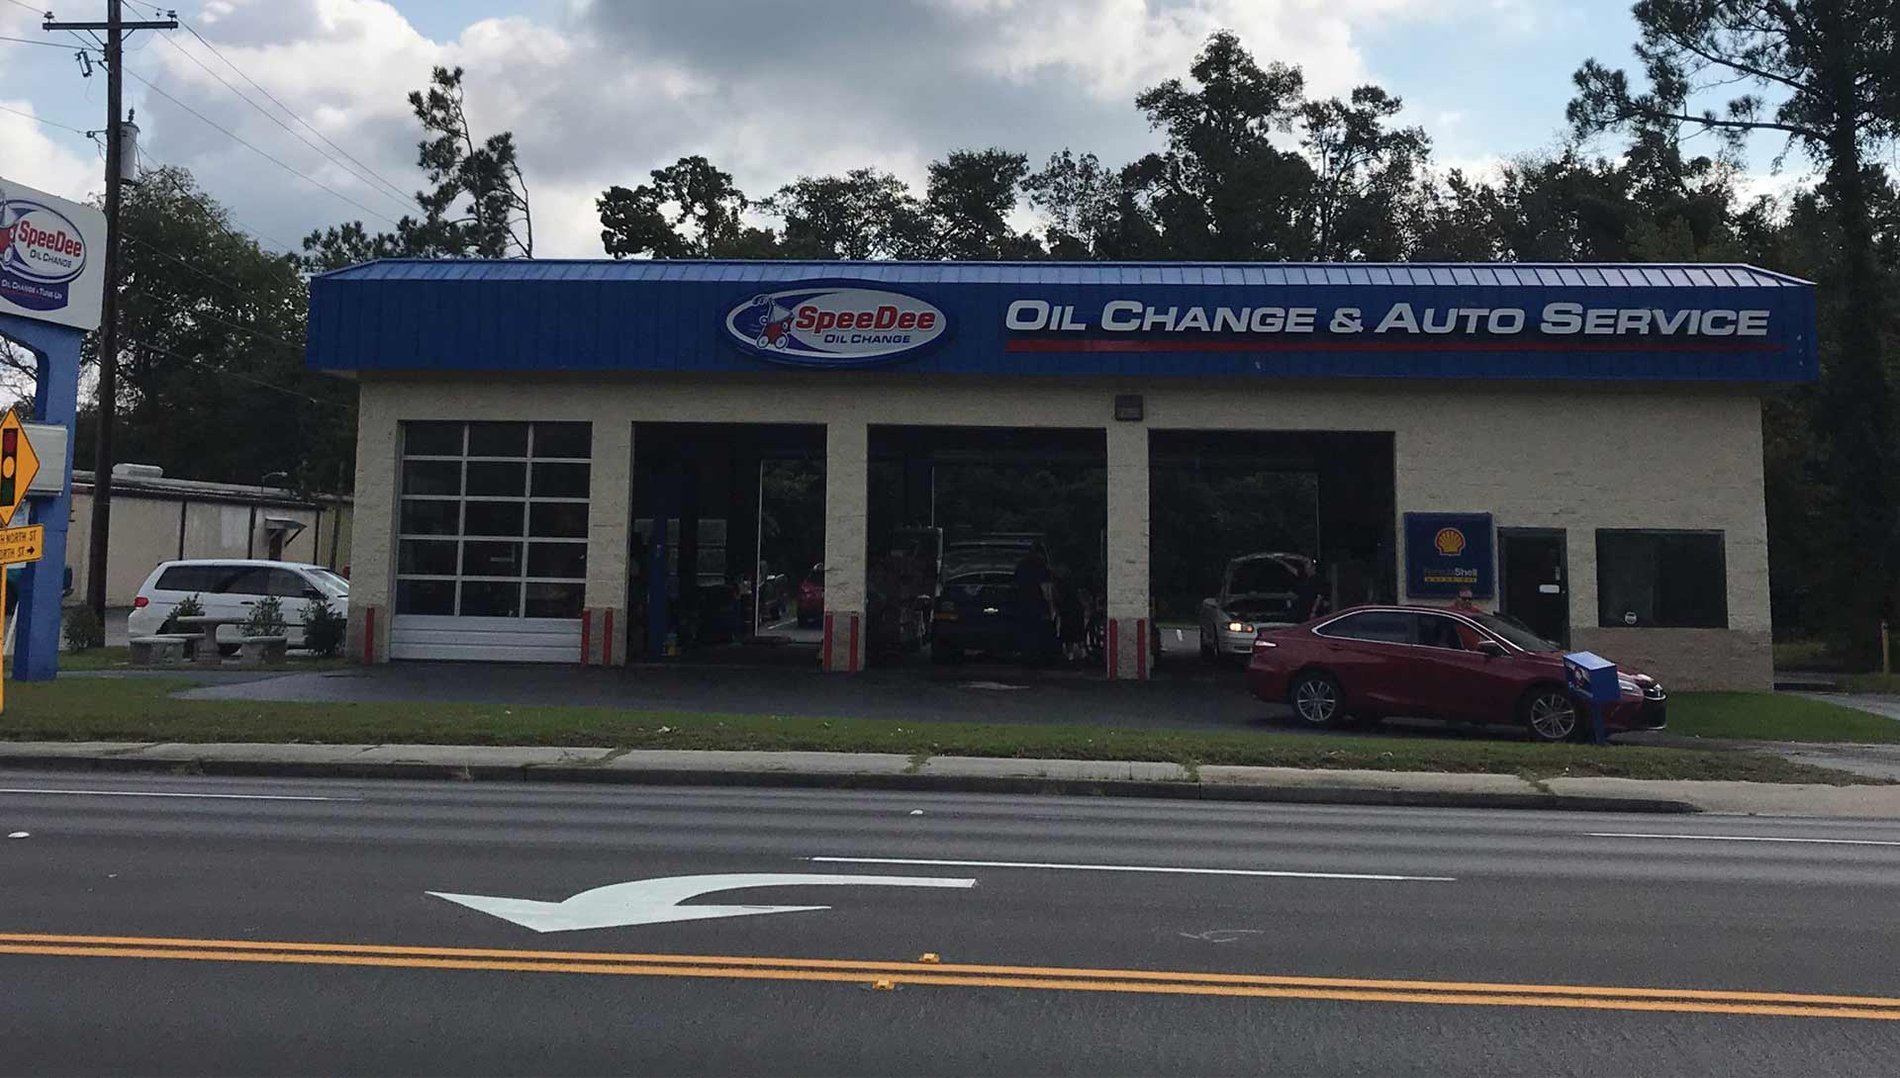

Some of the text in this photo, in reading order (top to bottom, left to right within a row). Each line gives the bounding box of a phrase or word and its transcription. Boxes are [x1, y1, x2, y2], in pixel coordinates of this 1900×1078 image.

[18, 220, 82, 258] SpeeDee
[30, 249, 72, 268] OIL CHANGE
[796, 306, 935, 334] SpeeDee
[1005, 300, 1770, 336] OIL CHANGE & AUTO SERVICE
[824, 334, 911, 344] OIL CHANGE
